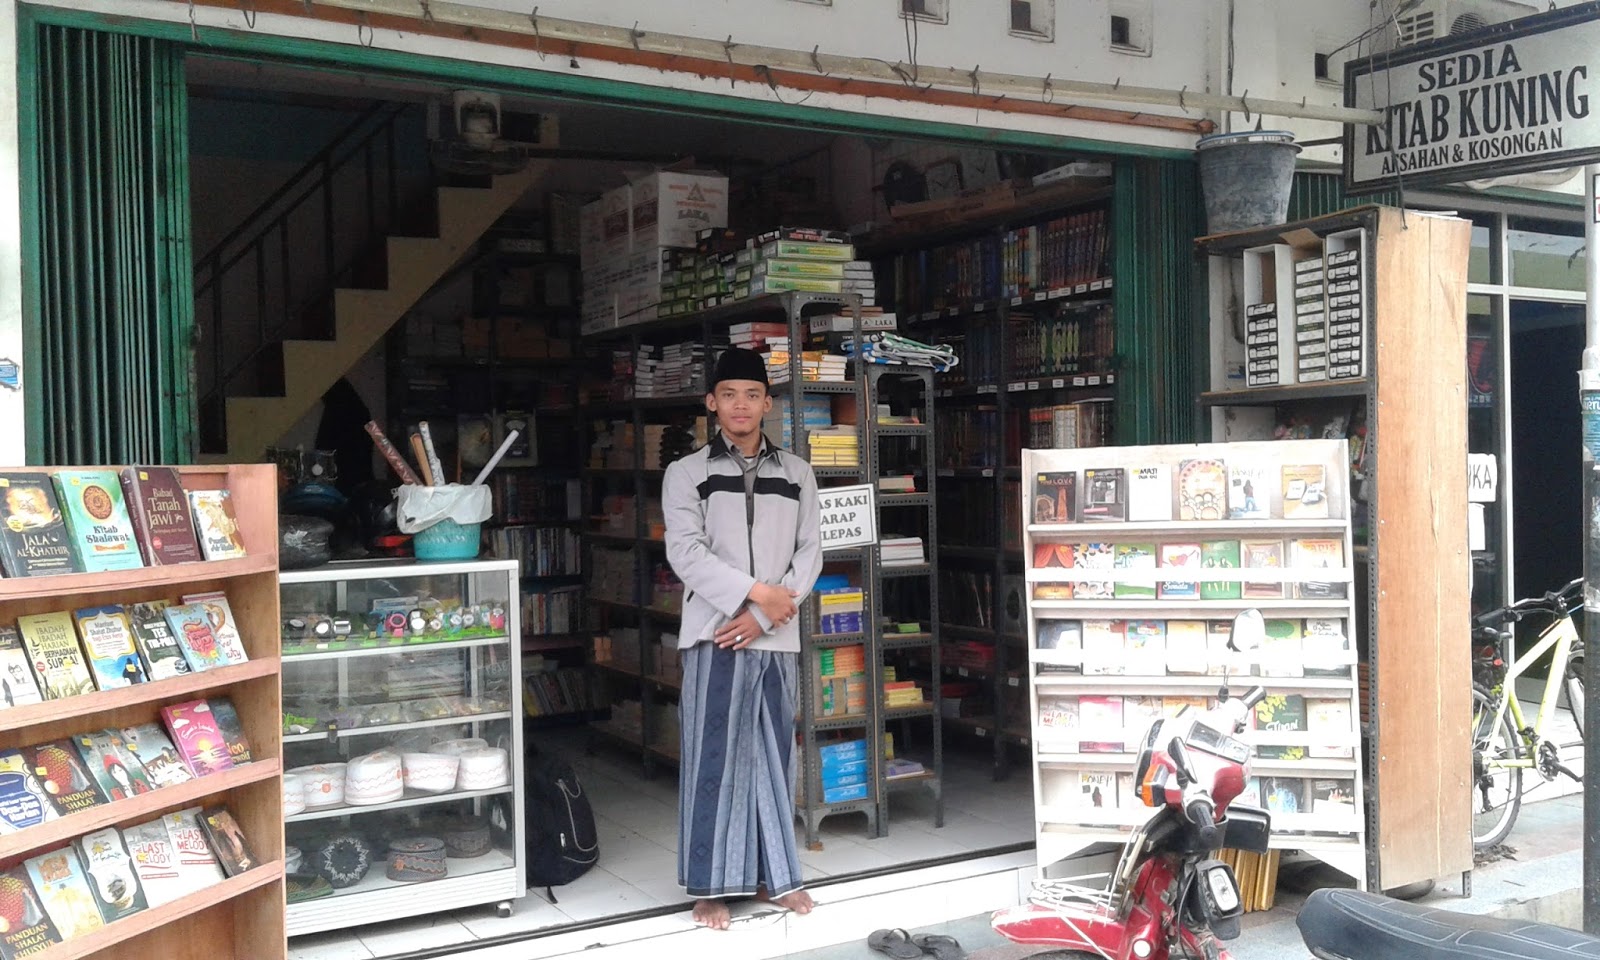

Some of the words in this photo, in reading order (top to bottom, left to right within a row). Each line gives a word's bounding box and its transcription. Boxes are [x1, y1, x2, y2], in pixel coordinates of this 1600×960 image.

[1418, 44, 1522, 93] SEDIA
[1365, 94, 1450, 156] KITAB
[1459, 65, 1589, 138] KUNING
[1453, 143, 1464, 163] &
[1469, 127, 1563, 162] KOSONGAN
[874, 319, 893, 327] LAKA
[1469, 464, 1492, 489] KA
[152, 488, 174, 497] Babad
[148, 497, 181, 512] Tanah
[834, 495, 868, 508] KAKI
[147, 510, 173, 530] Jawi
[93, 525, 118, 534] Kitab
[86, 533, 130, 544] Shalawat
[16, 546, 71, 558] AL-KHATHIR
[39, 632, 67, 642] IBADAH
[41, 640, 69, 650] HARIAN
[43, 647, 78, 659] BERHADIAH
[46, 655, 79, 669] SURA!
[56, 789, 96, 805] PANDUAN
[65, 797, 95, 811] SHALAT
[141, 842, 165, 854] LAST
[5, 922, 49, 945] PANDUAN
[14, 932, 47, 951] SHALAT
